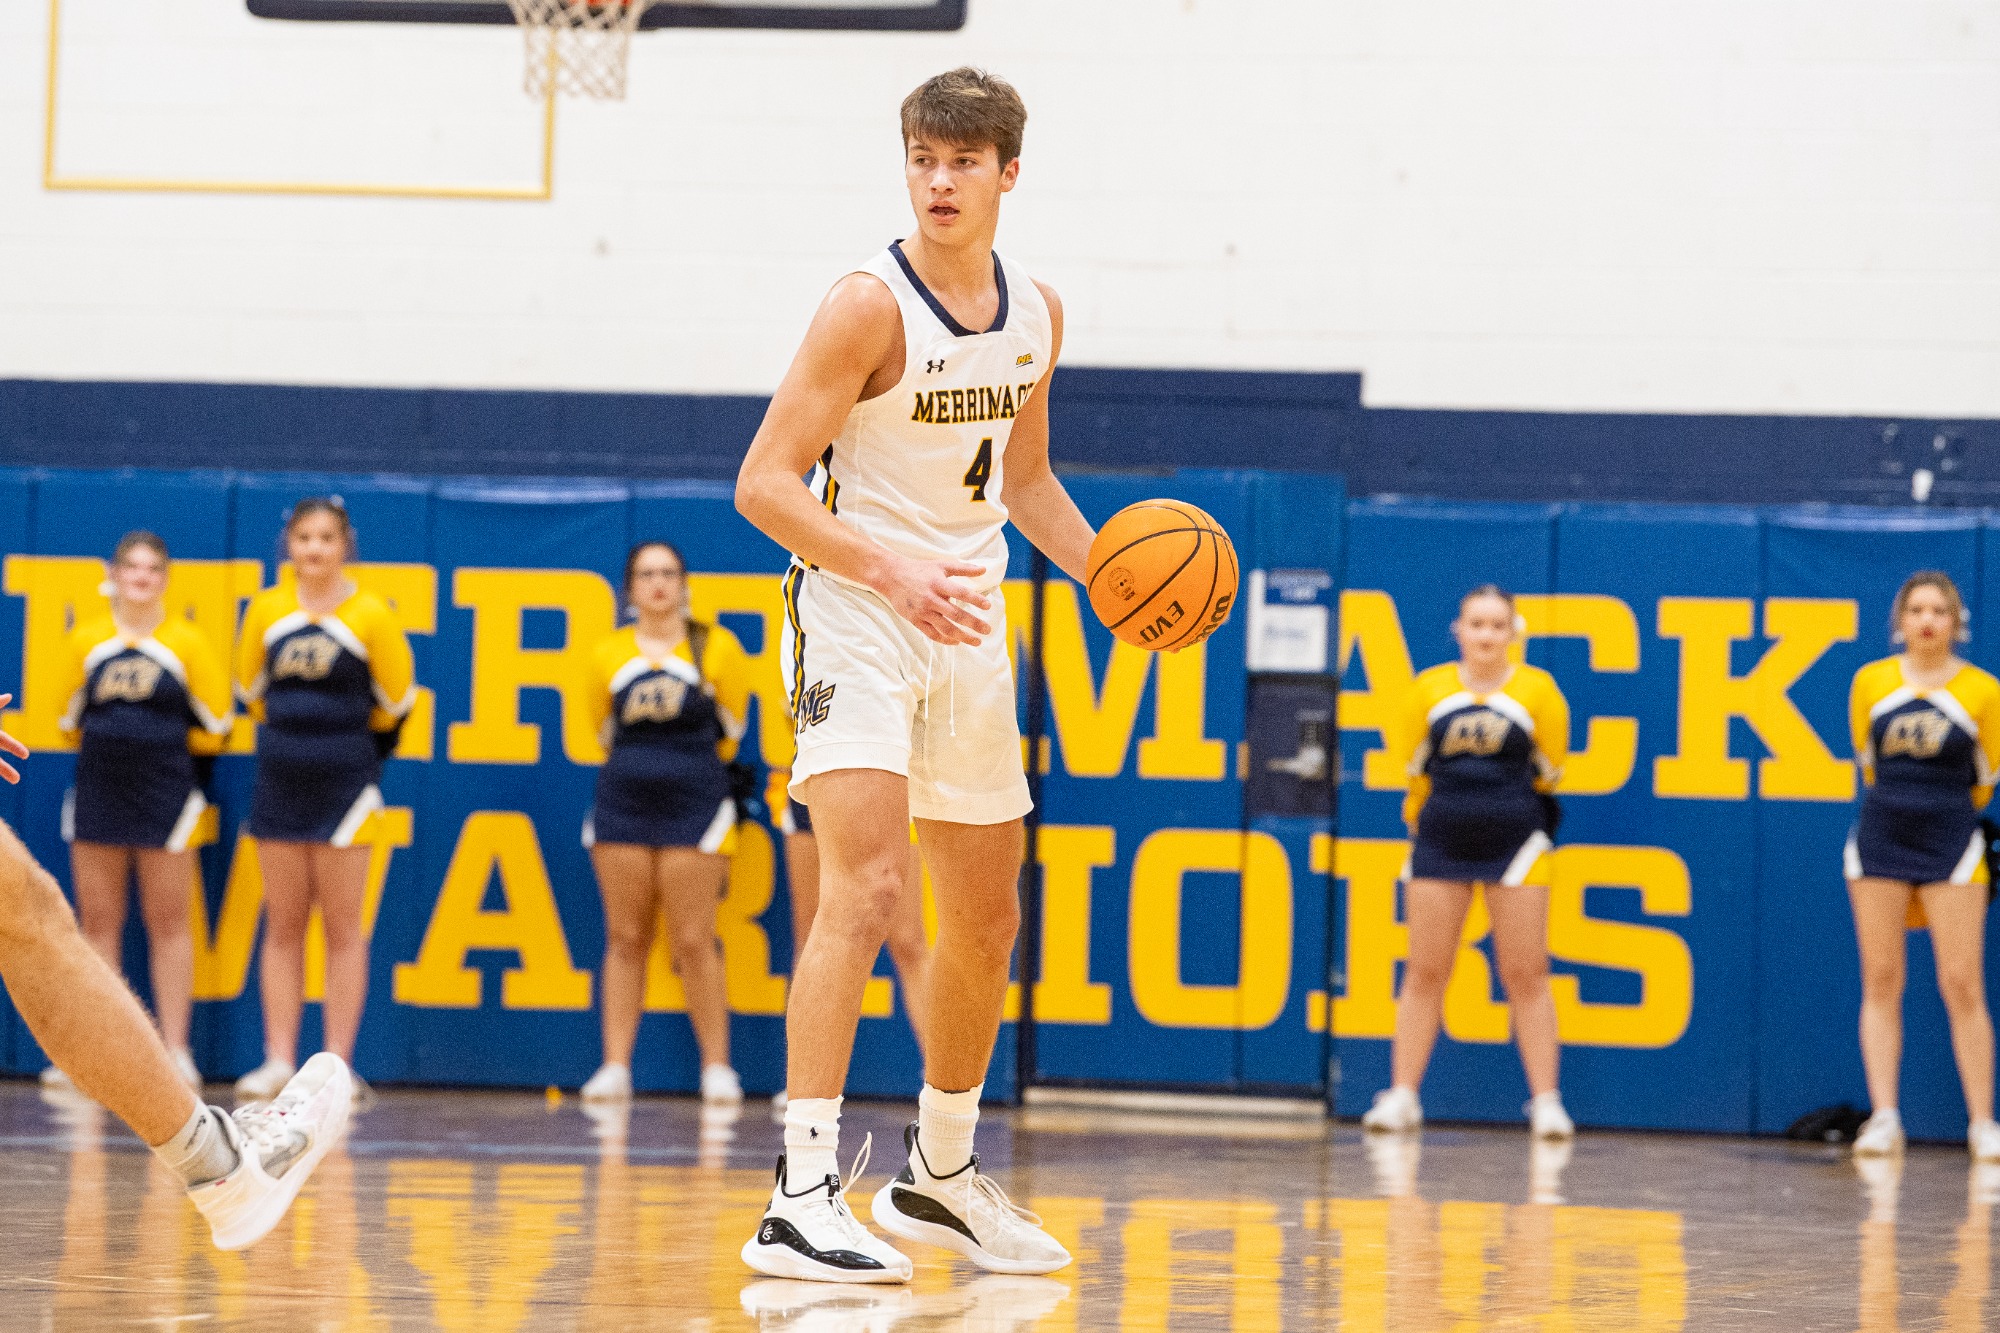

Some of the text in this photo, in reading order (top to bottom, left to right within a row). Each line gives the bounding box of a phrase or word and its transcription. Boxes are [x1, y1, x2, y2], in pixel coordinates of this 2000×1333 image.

[911, 383, 1035, 424] MERRIMAC
[962, 437, 993, 502] 4
[1140, 600, 1185, 643] EVO
[1, 554, 1858, 801] MRRMACK
[186, 806, 1694, 1048] WARIORS
